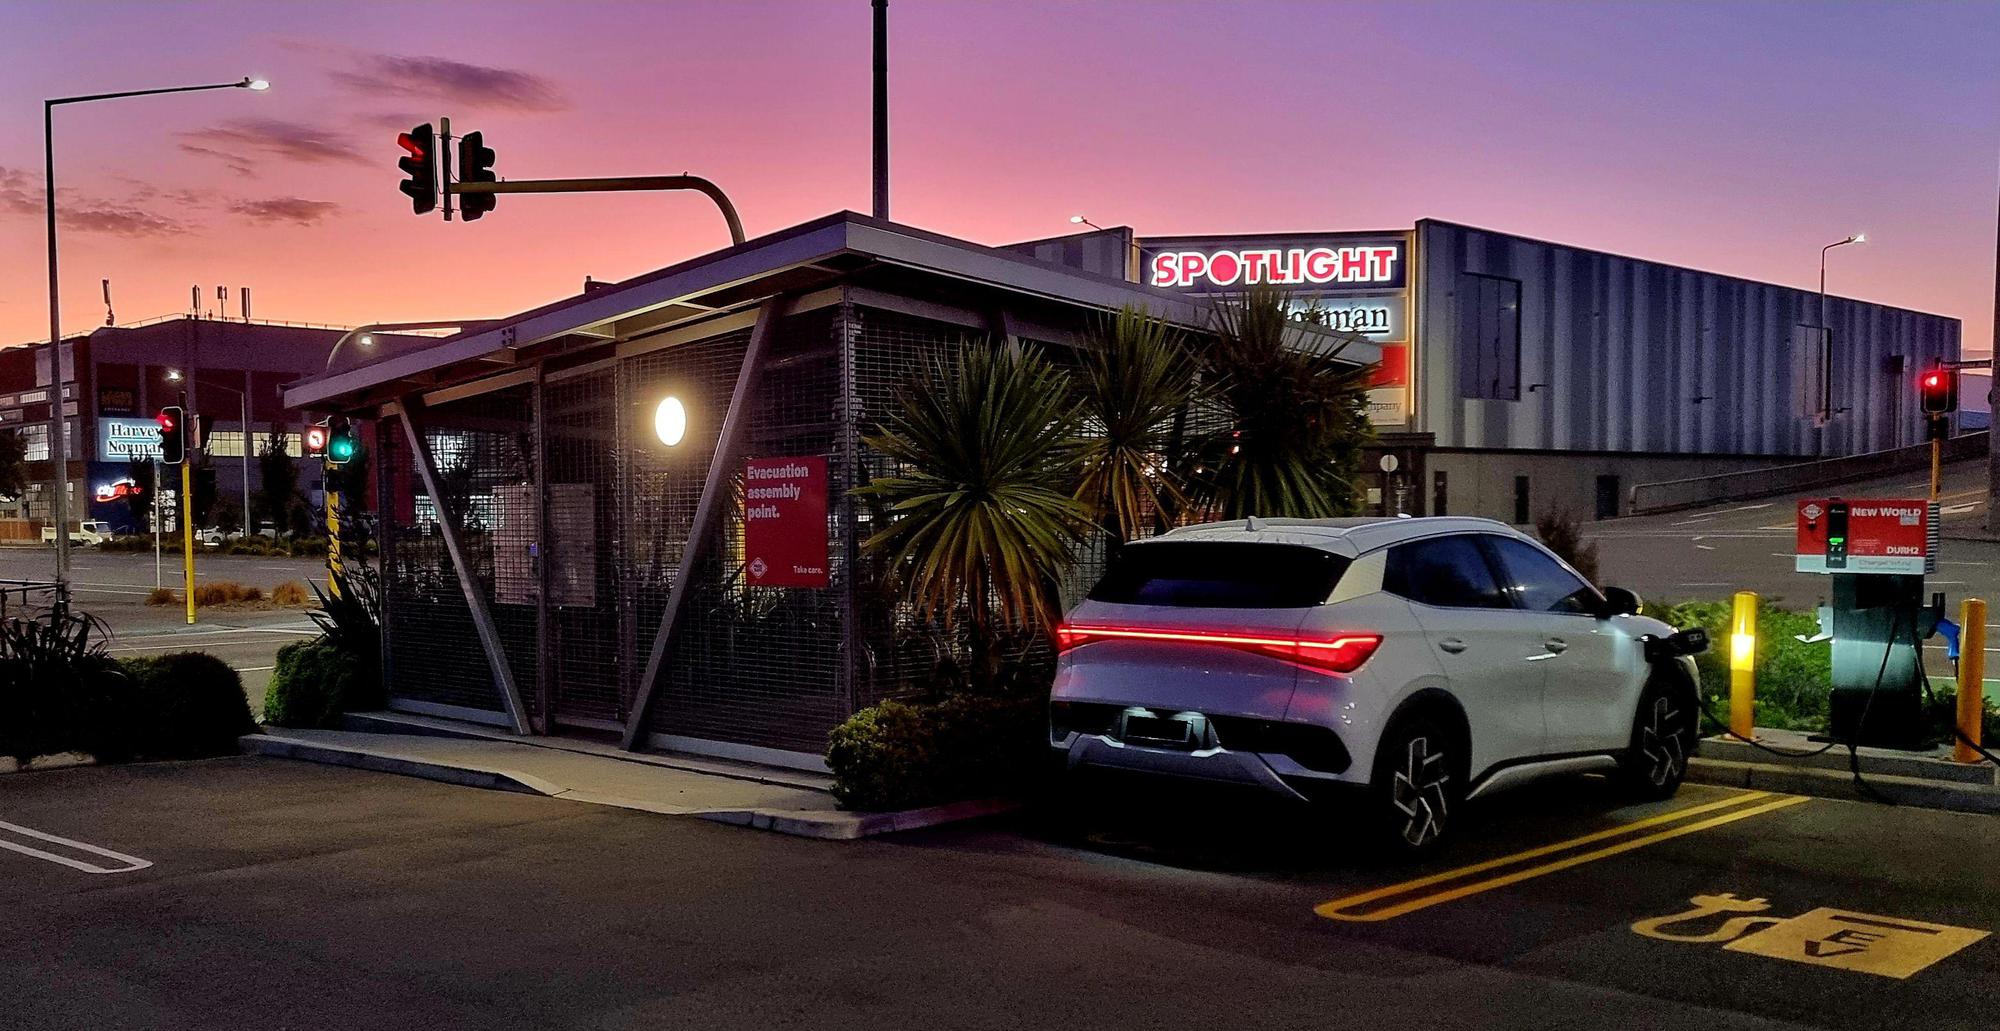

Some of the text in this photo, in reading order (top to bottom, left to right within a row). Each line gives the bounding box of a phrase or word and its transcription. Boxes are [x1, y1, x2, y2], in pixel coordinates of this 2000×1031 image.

[1153, 248, 1396, 286] SPOTLIGHT
[110, 424, 162, 441] Harvey
[747, 463, 809, 480] Evacuation
[747, 483, 801, 501] assembly
[747, 504, 780, 521] point.
[1852, 507, 1878, 517] NEW
[1880, 507, 1922, 517] WORLD
[1886, 546, 1919, 555] DURH2
[793, 565, 823, 574] Take care.
[1805, 929, 1887, 958] EV
